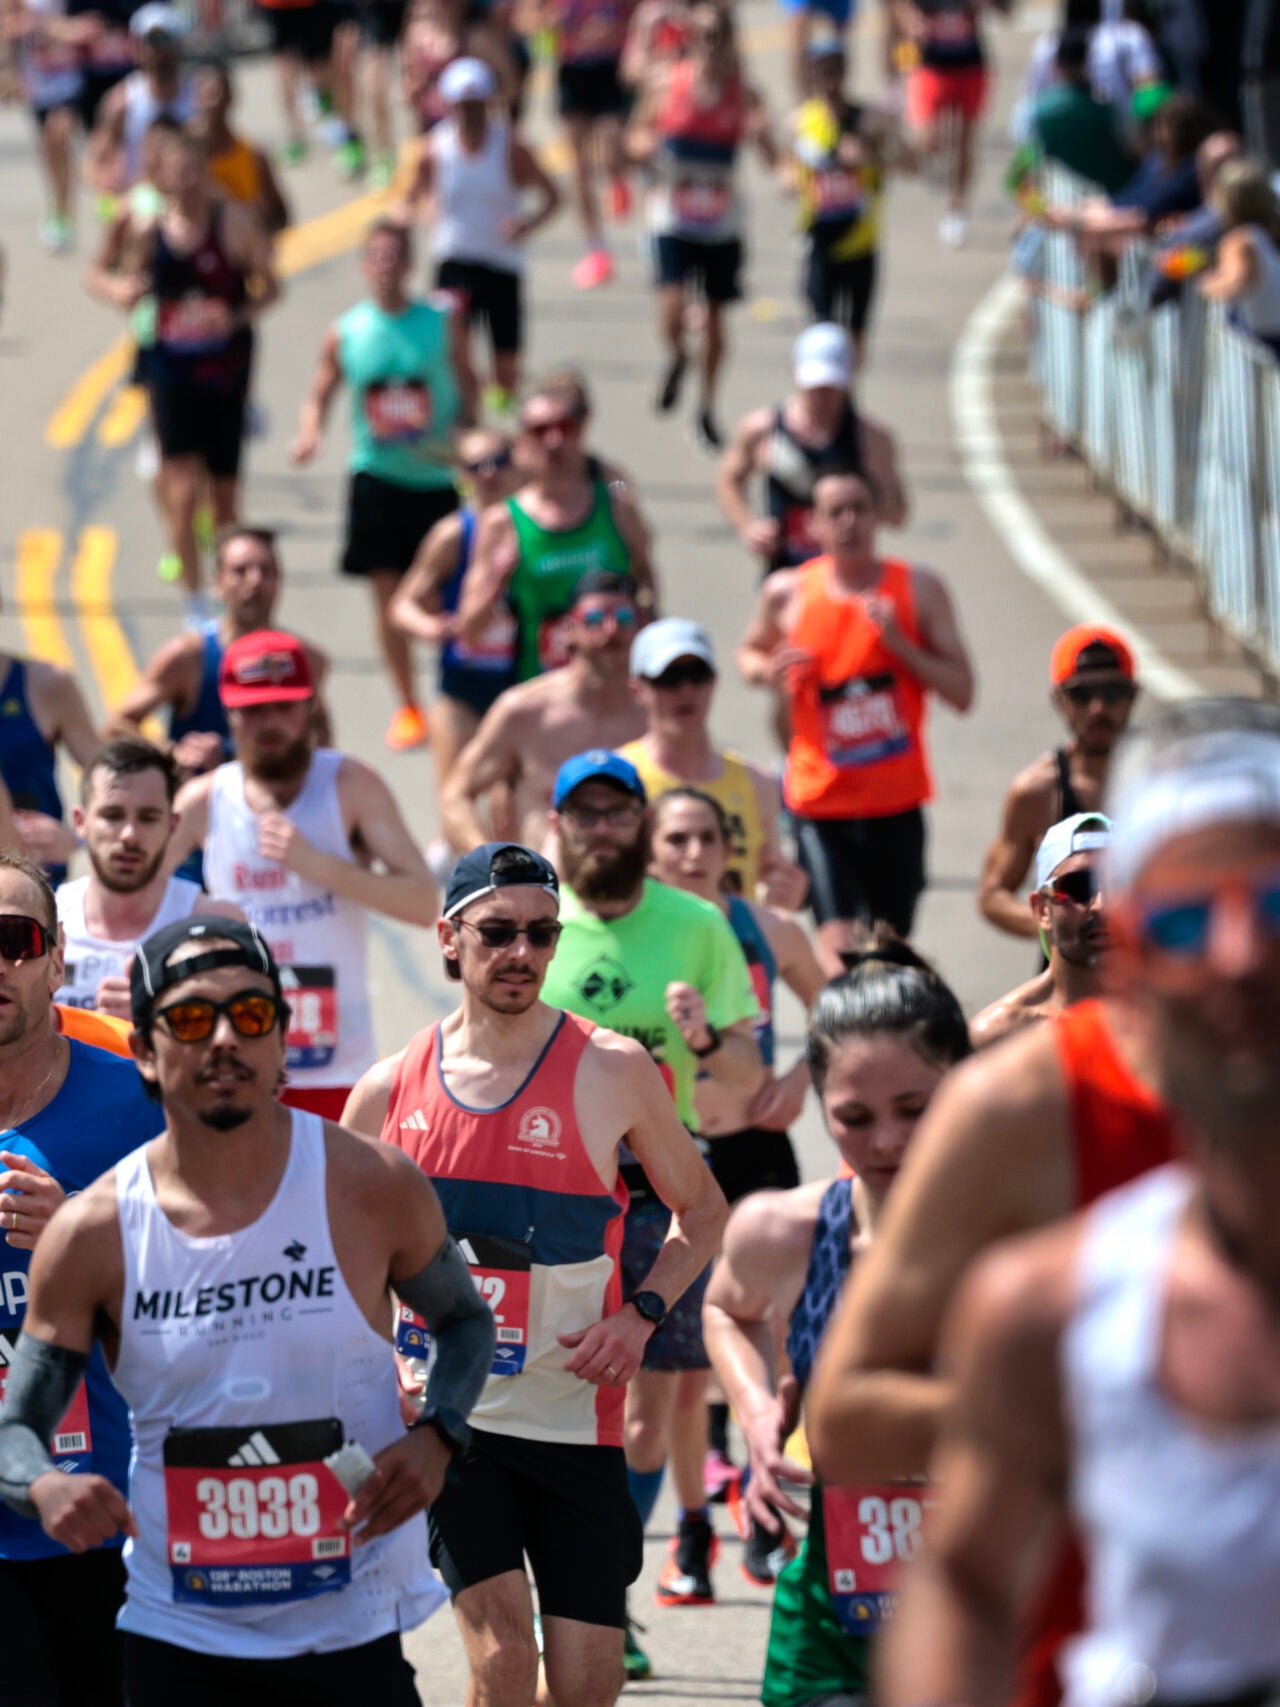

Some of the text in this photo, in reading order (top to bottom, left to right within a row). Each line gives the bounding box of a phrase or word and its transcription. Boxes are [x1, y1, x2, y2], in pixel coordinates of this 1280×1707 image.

[133, 1266, 335, 1321] MILESTONE
[177, 1306, 293, 1337] RUNNING
[196, 1473, 321, 1540] 3938
[858, 1495, 932, 1565] 38
[210, 1580, 292, 1593] MARATHON
[237, 1567, 292, 1582] BOSTON
